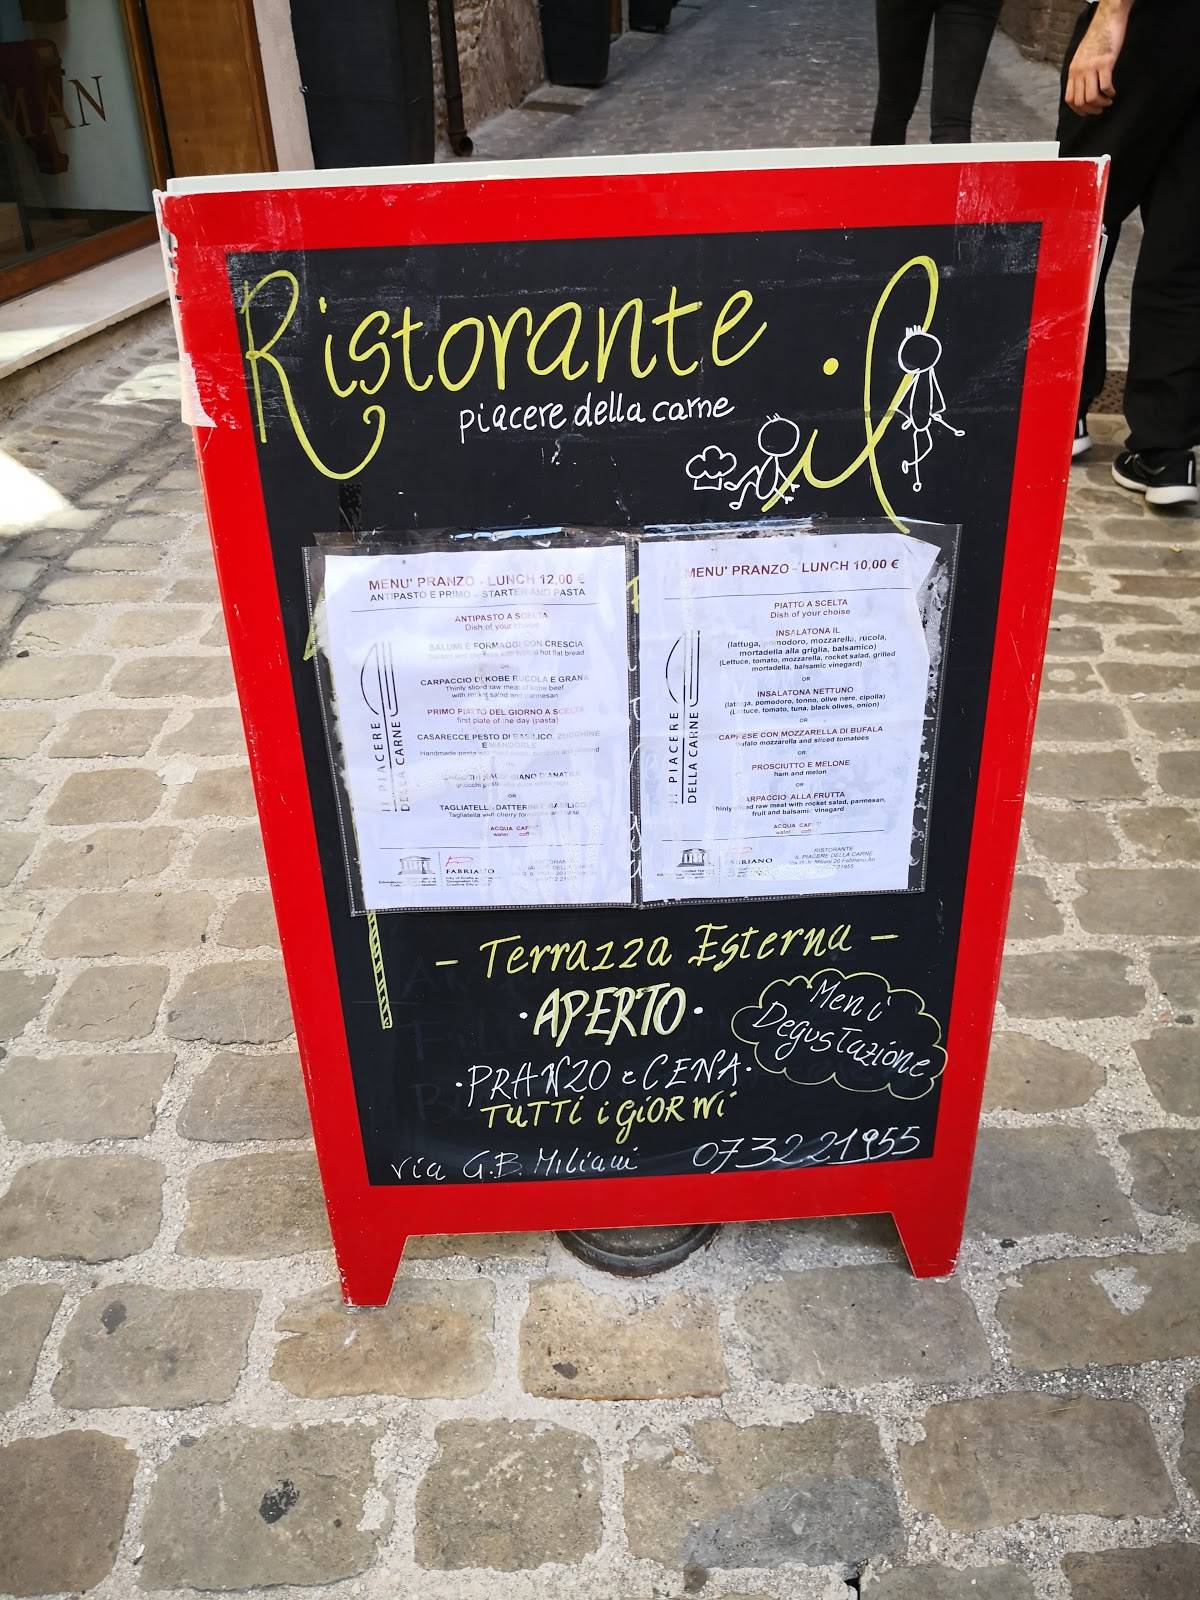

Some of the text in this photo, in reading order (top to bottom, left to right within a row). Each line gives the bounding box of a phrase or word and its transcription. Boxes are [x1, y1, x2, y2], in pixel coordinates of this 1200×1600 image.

[240, 269, 767, 480] Ristorante
[459, 390, 735, 444] piacere della carne
[732, 564, 789, 576] PRANZO
[802, 561, 849, 573] LUNCH
[854, 560, 886, 571] 10,00
[891, 559, 899, 569] €
[369, 577, 412, 591] MENU'
[430, 591, 436, 599] E
[775, 601, 805, 609] PIATTO
[815, 599, 848, 607] SCELTA
[455, 613, 504, 623] ANTIPASTO
[770, 611, 789, 619] Dish
[802, 610, 820, 618] your
[859, 634, 887, 642] rucola,
[545, 640, 584, 648] CRESCIA
[802, 647, 829, 655] griglia,
[832, 643, 877, 652] balsamico)
[720, 658, 750, 666] (Lettuce,
[873, 650, 896, 659] grilled
[752, 664, 791, 672] mortadella,
[794, 662, 826, 670] balsamic
[420, 677, 472, 686] CARPACCIO
[757, 687, 853, 697] INSALATONA NETTUNO
[859, 694, 886, 702] cipolla)
[811, 703, 829, 711] black
[781, 729, 838, 737] MOZZARELLA
[850, 726, 883, 734] BUFALA
[391, 721, 405, 765] CARNE
[669, 712, 678, 783] PIACERE
[371, 722, 386, 792] PIACERE
[688, 712, 698, 803] DELLA CARNE
[752, 762, 805, 771] PROSCIUTTO
[813, 791, 845, 799] FRUTTA
[687, 923, 852, 972] Esterna
